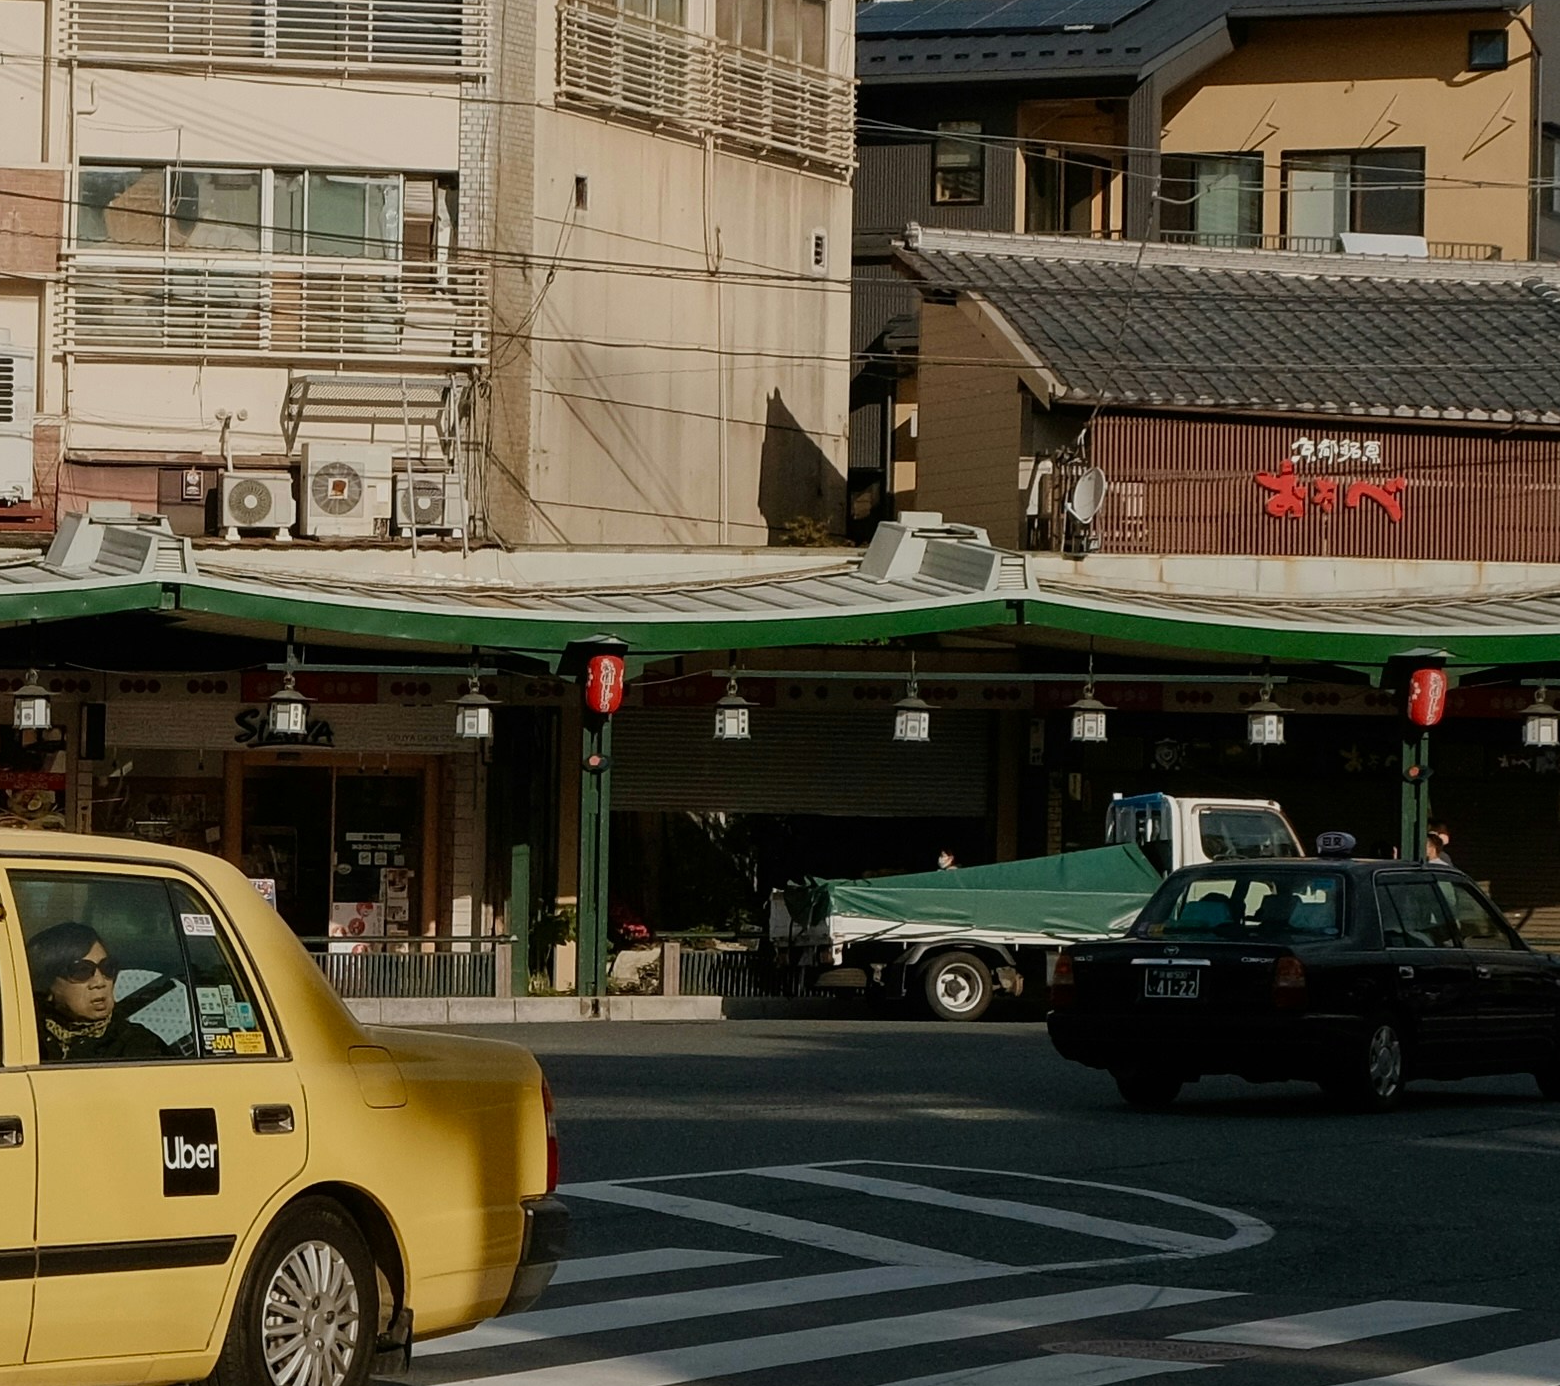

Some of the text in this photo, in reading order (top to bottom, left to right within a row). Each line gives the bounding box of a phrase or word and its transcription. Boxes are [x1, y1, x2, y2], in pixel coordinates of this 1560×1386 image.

[1255, 458, 1407, 523] おたべ
[1157, 980, 1196, 997] 41-22
[163, 1135, 218, 1170] Uber
